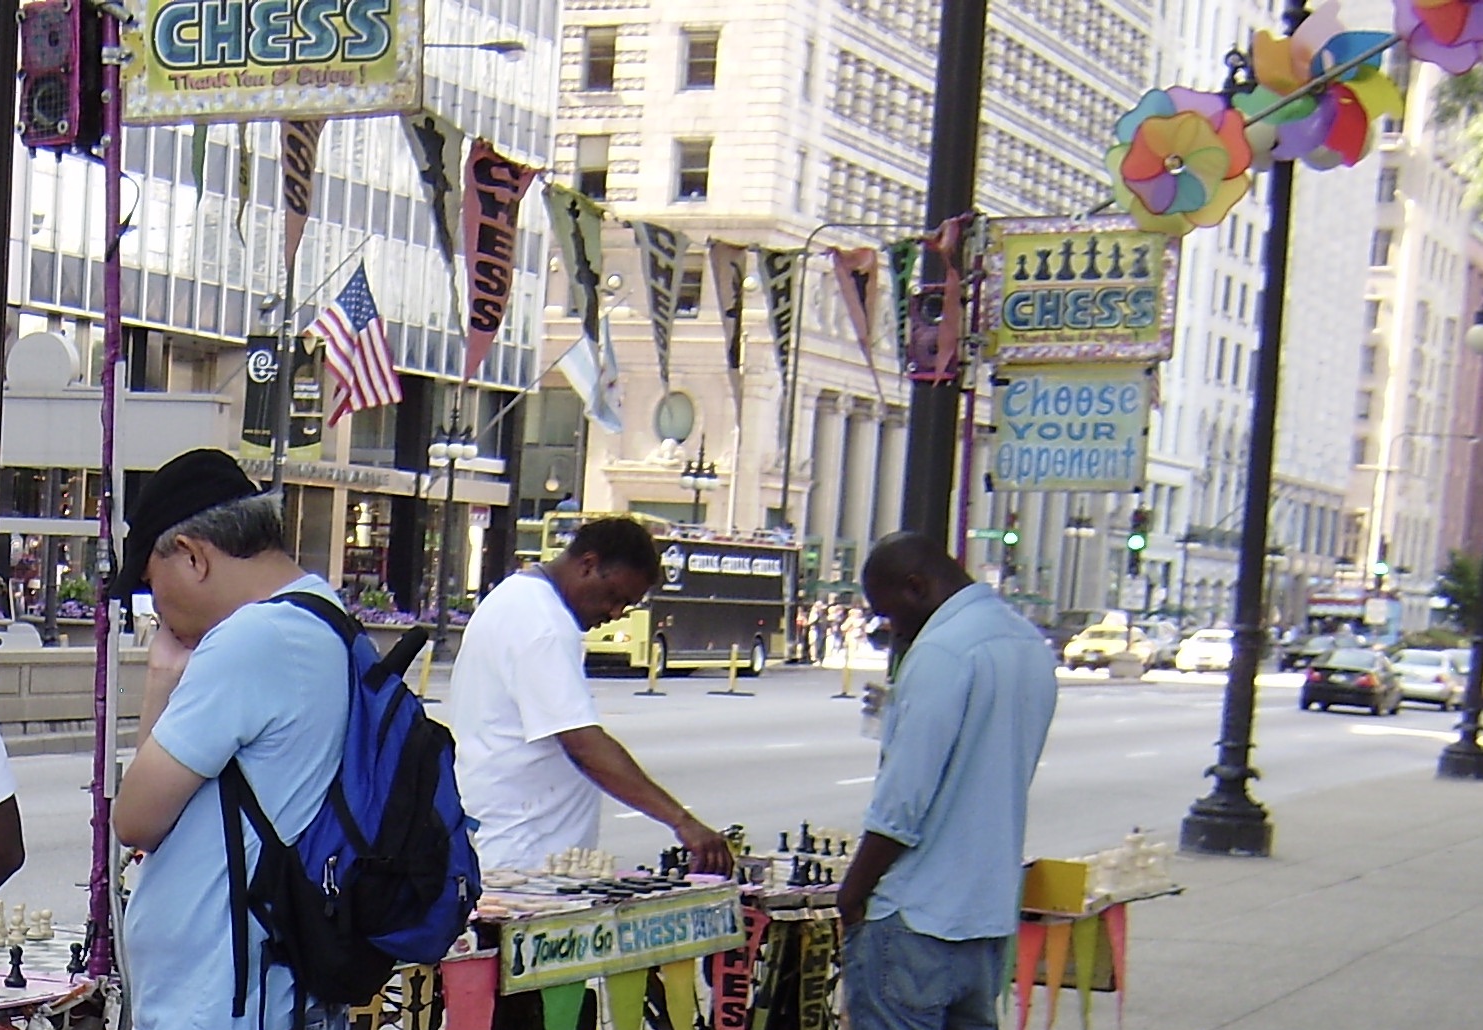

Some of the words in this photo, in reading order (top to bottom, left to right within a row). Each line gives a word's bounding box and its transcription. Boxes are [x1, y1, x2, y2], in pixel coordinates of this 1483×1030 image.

[152, 0, 391, 69] CHESS
[168, 71, 230, 90] Thank
[234, 69, 266, 88] You
[471, 156, 521, 333] CHESS
[1002, 286, 1158, 331] CHESS
[1003, 378, 1140, 416] Choose
[1009, 422, 1116, 441] YOUR
[530, 928, 576, 967] Touch
[590, 924, 614, 956] Go
[618, 911, 688, 951] CHESS
